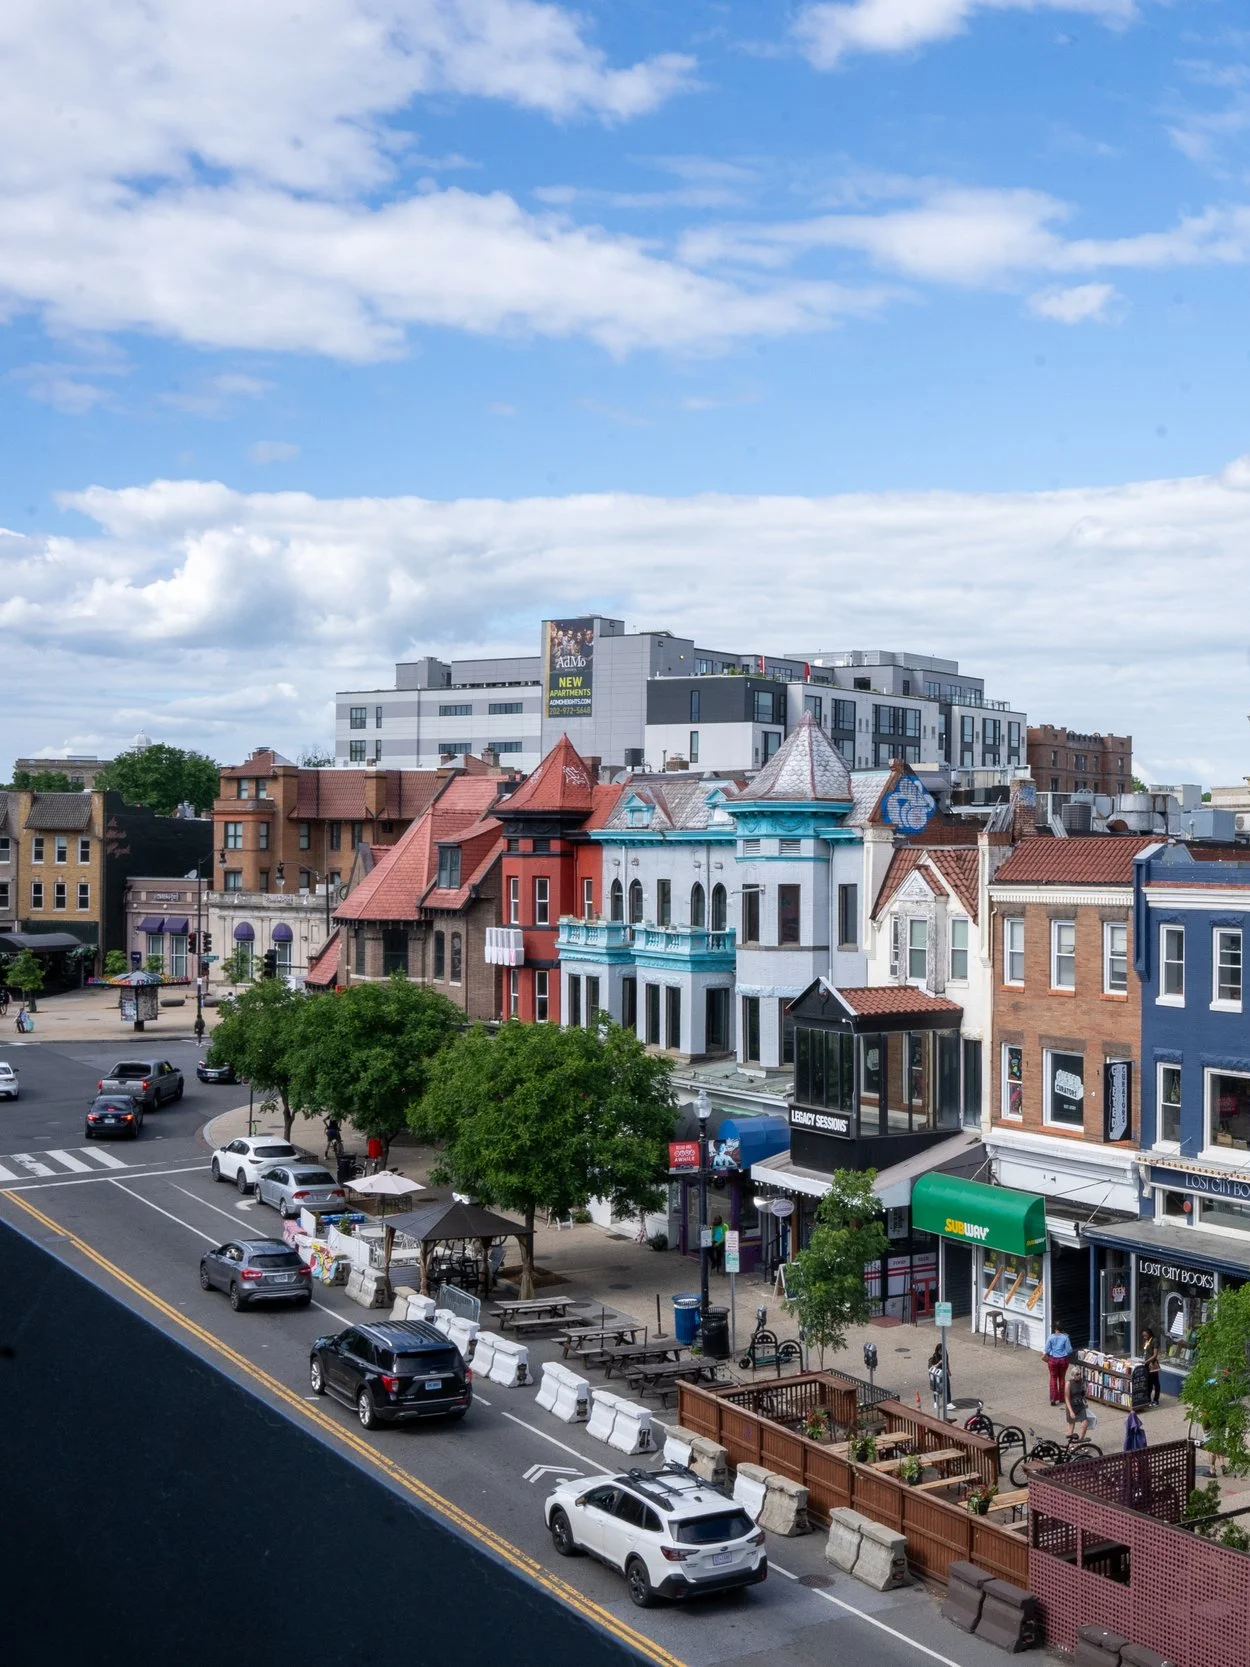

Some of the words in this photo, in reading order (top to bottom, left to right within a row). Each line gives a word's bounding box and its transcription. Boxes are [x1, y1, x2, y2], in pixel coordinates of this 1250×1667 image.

[556, 655, 586, 668] AdMo
[559, 676, 583, 688] NEW
[550, 688, 591, 697] APARTMENTS
[1056, 1083, 1078, 1098] CURATORS
[791, 1109, 815, 1126] LEGACY
[815, 1114, 847, 1132] SESSIONS
[1185, 1174, 1209, 1191] LOST
[1211, 1178, 1231, 1195] CITY
[945, 1218, 989, 1240] SUBWAY
[1026, 1237, 1046, 1247] SUBWAY
[1140, 1260, 1161, 1277] LOST
[1162, 1266, 1180, 1281] CITY
[1181, 1270, 1214, 1289] BOOKS
